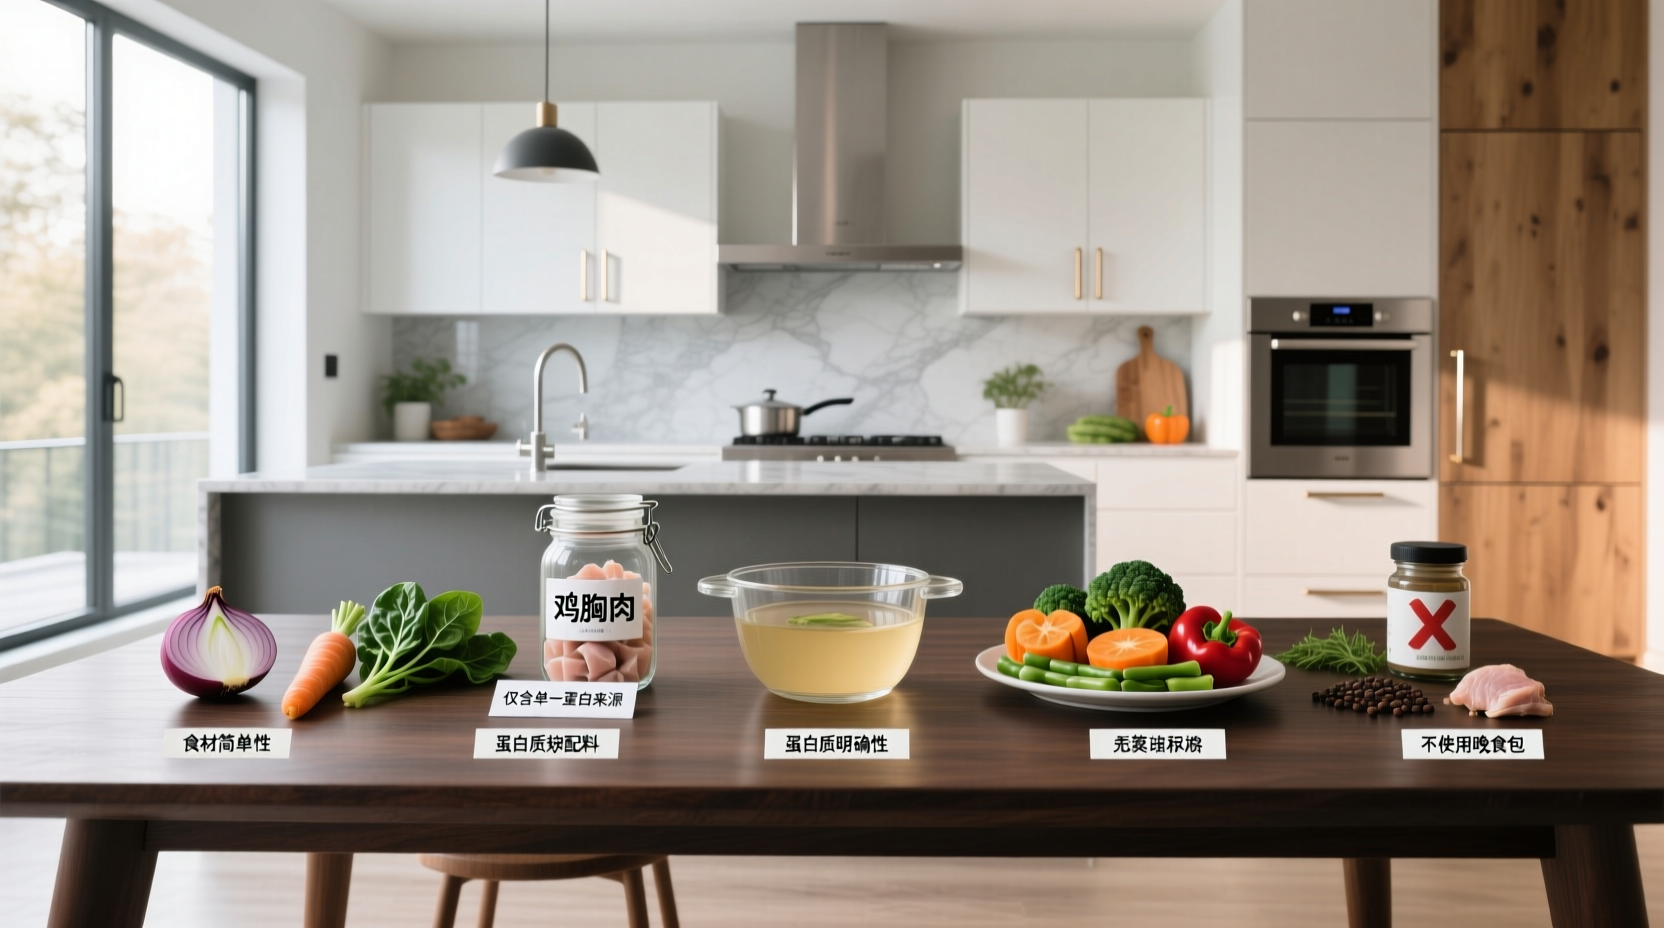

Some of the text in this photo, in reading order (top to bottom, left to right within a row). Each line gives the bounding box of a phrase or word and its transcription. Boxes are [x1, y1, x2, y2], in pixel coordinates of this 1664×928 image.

[554, 591, 635, 623] 鸡胸肉
[183, 733, 271, 753] 食材简单性
[785, 734, 889, 754] 蛋白质明确性
